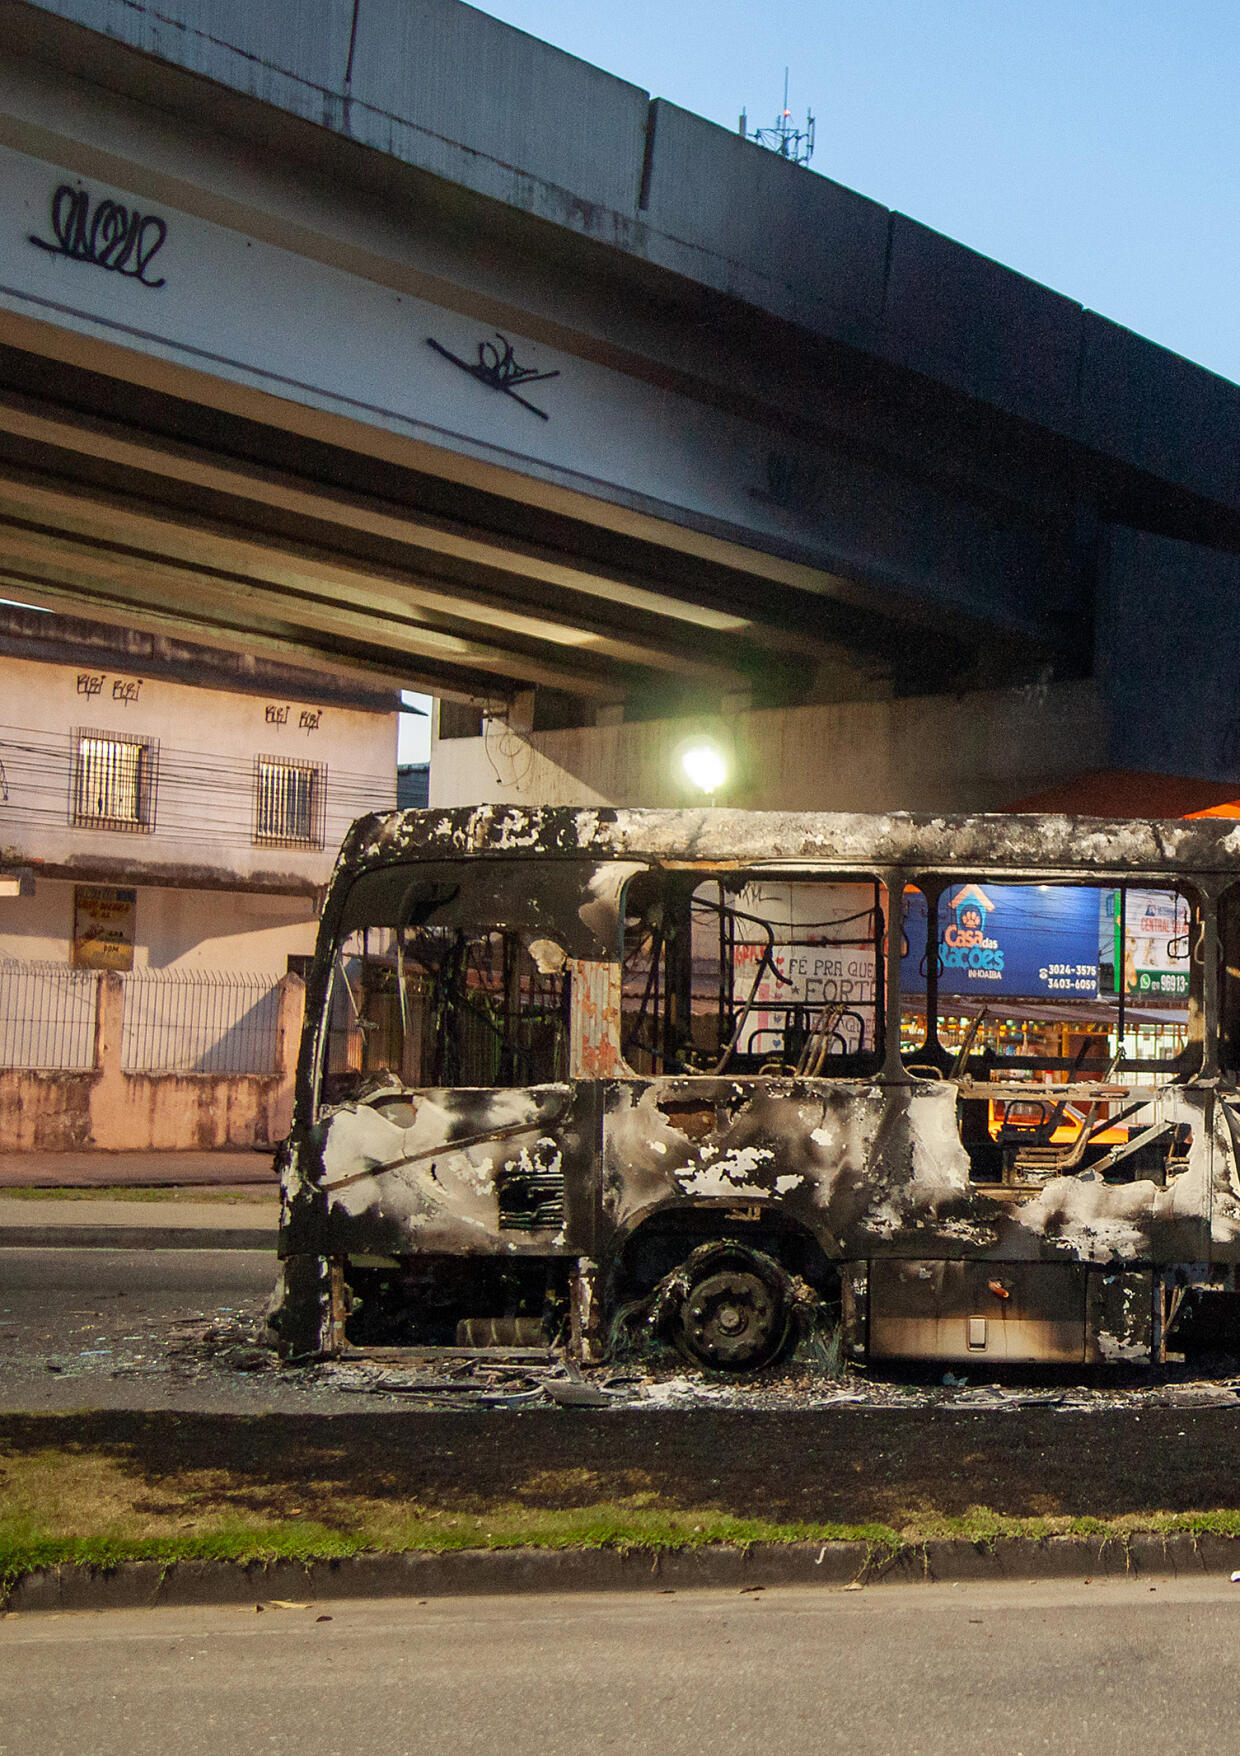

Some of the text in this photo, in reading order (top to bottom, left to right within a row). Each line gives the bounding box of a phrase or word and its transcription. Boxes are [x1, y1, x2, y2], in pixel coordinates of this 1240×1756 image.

[945, 924, 999, 948] Casa das
[789, 956, 807, 976] FÉ
[813, 959, 843, 977] PRA
